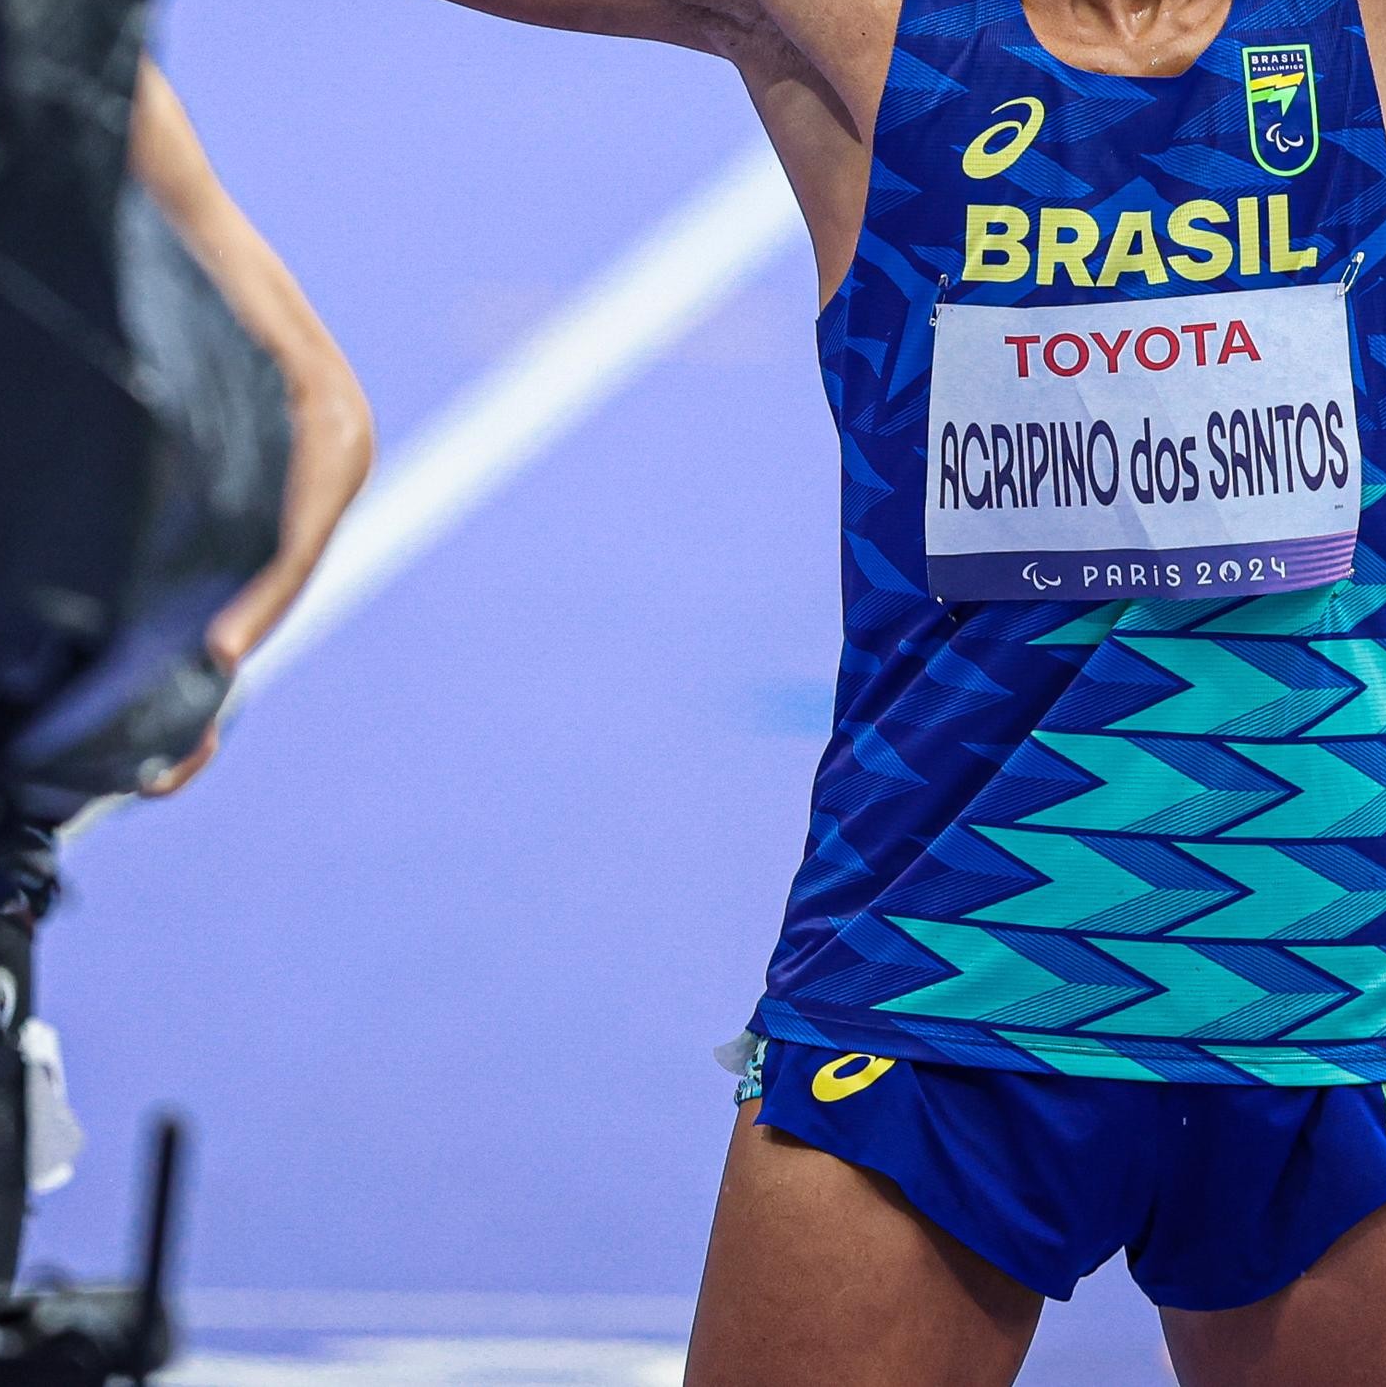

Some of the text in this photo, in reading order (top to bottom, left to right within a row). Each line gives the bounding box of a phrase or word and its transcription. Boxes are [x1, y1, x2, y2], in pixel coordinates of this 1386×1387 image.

[1251, 53, 1304, 64] BRASIL
[962, 194, 1317, 286] BRASIL
[1004, 320, 1261, 378] TOYOTA
[939, 400, 1348, 510] AGRIPINO dos SANTOS
[1196, 556, 1286, 585] 2024
